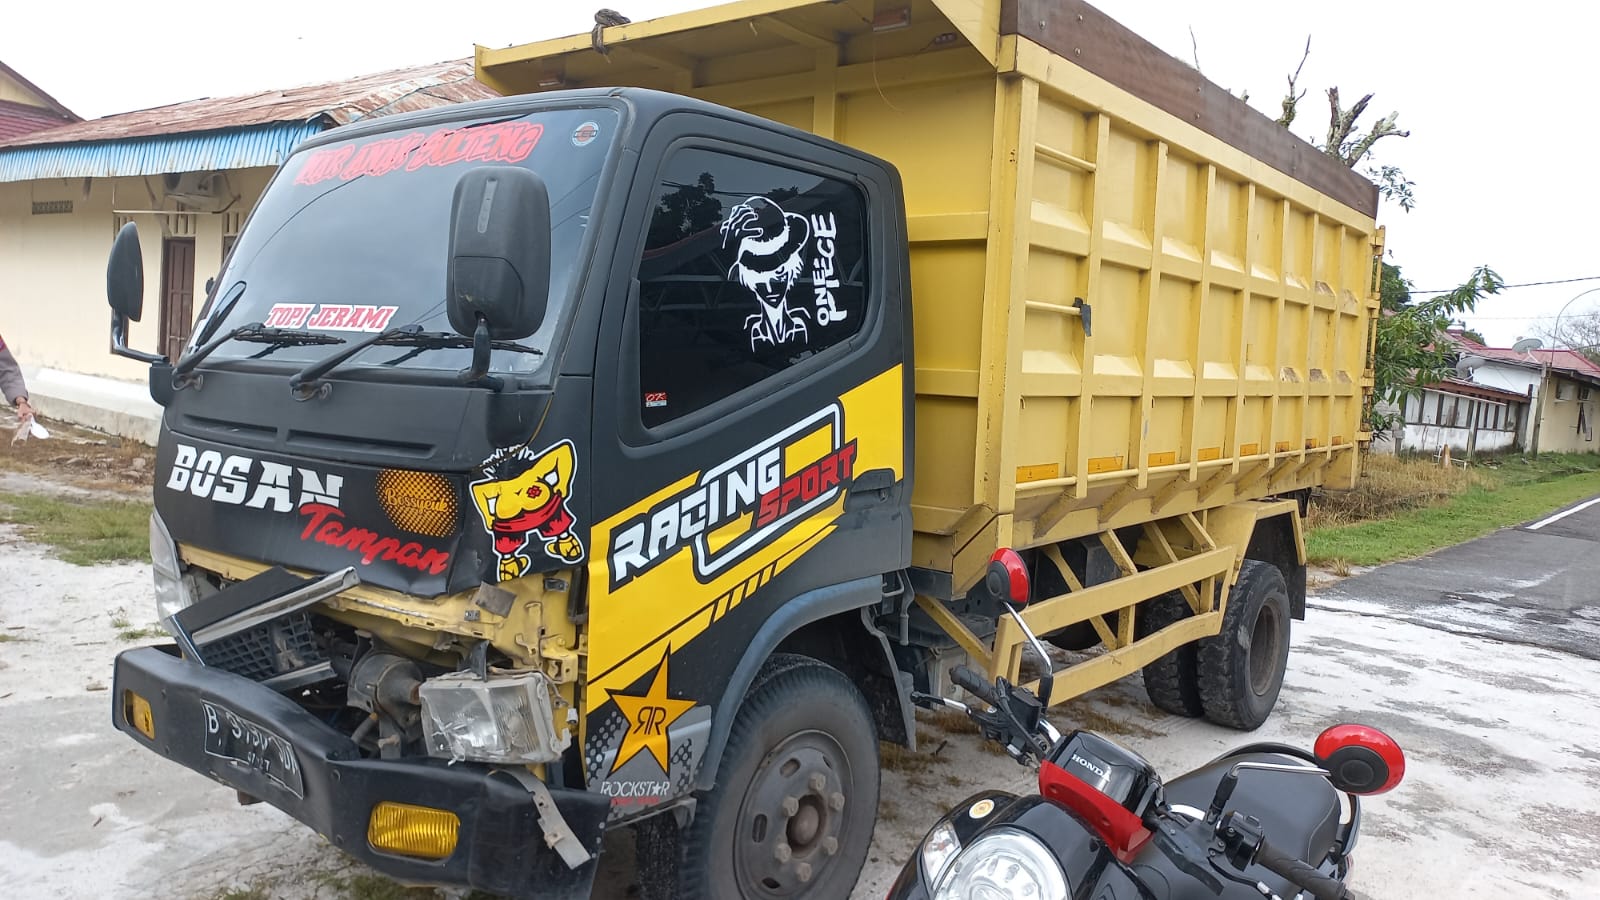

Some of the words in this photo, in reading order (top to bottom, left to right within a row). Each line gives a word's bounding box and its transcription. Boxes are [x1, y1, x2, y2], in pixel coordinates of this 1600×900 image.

[265, 306, 311, 328] TOPI
[308, 306, 394, 330] JERAMI
[813, 269, 830, 327] ONE
[166, 444, 344, 513] BOSAN
[756, 444, 856, 529] SPORT
[299, 504, 449, 575] Tampan
[613, 446, 780, 583] RACING
[204, 703, 220, 734] B
[1071, 753, 1111, 781] HONDA
